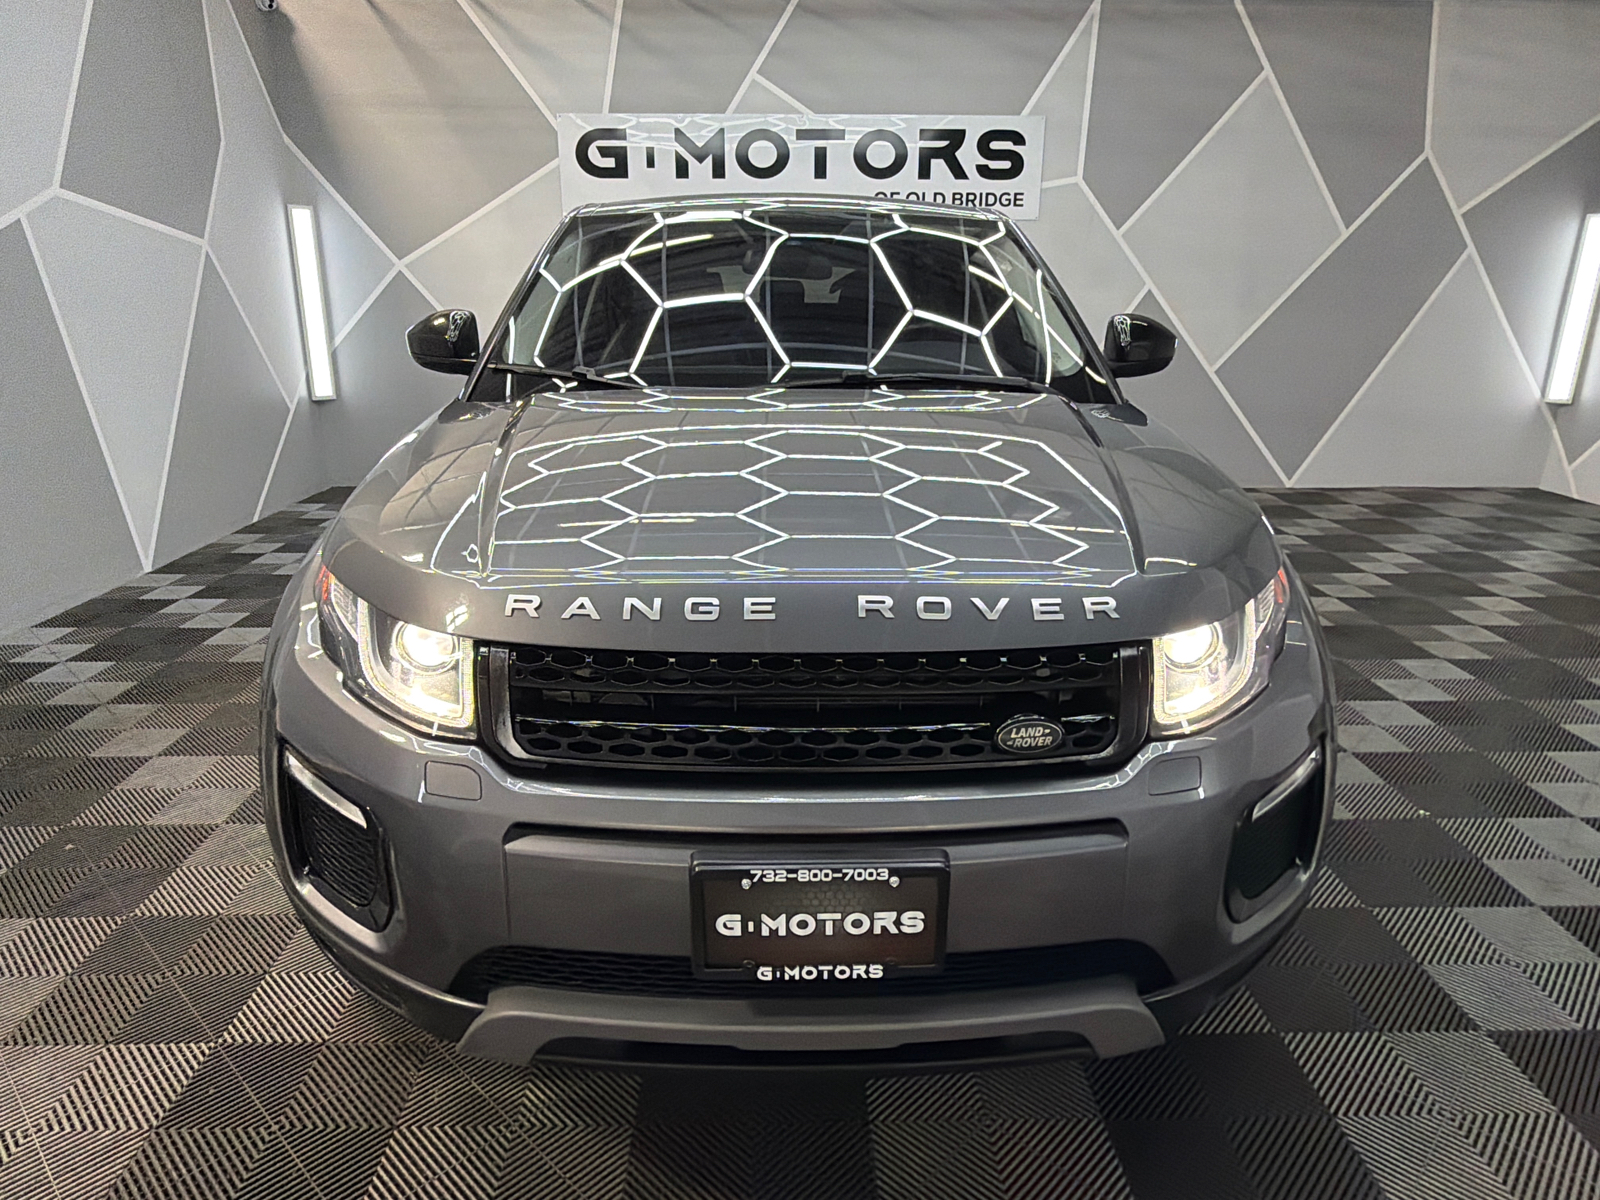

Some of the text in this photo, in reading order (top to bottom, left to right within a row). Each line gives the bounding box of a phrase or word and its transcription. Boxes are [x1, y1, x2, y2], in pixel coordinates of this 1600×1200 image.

[952, 192, 1025, 207] BRIDGE
[504, 594, 1121, 621] RANGE ROVER
[1010, 727, 1044, 738] LAND
[1012, 736, 1053, 748] ROVER
[750, 868, 889, 883] 732-800-7003
